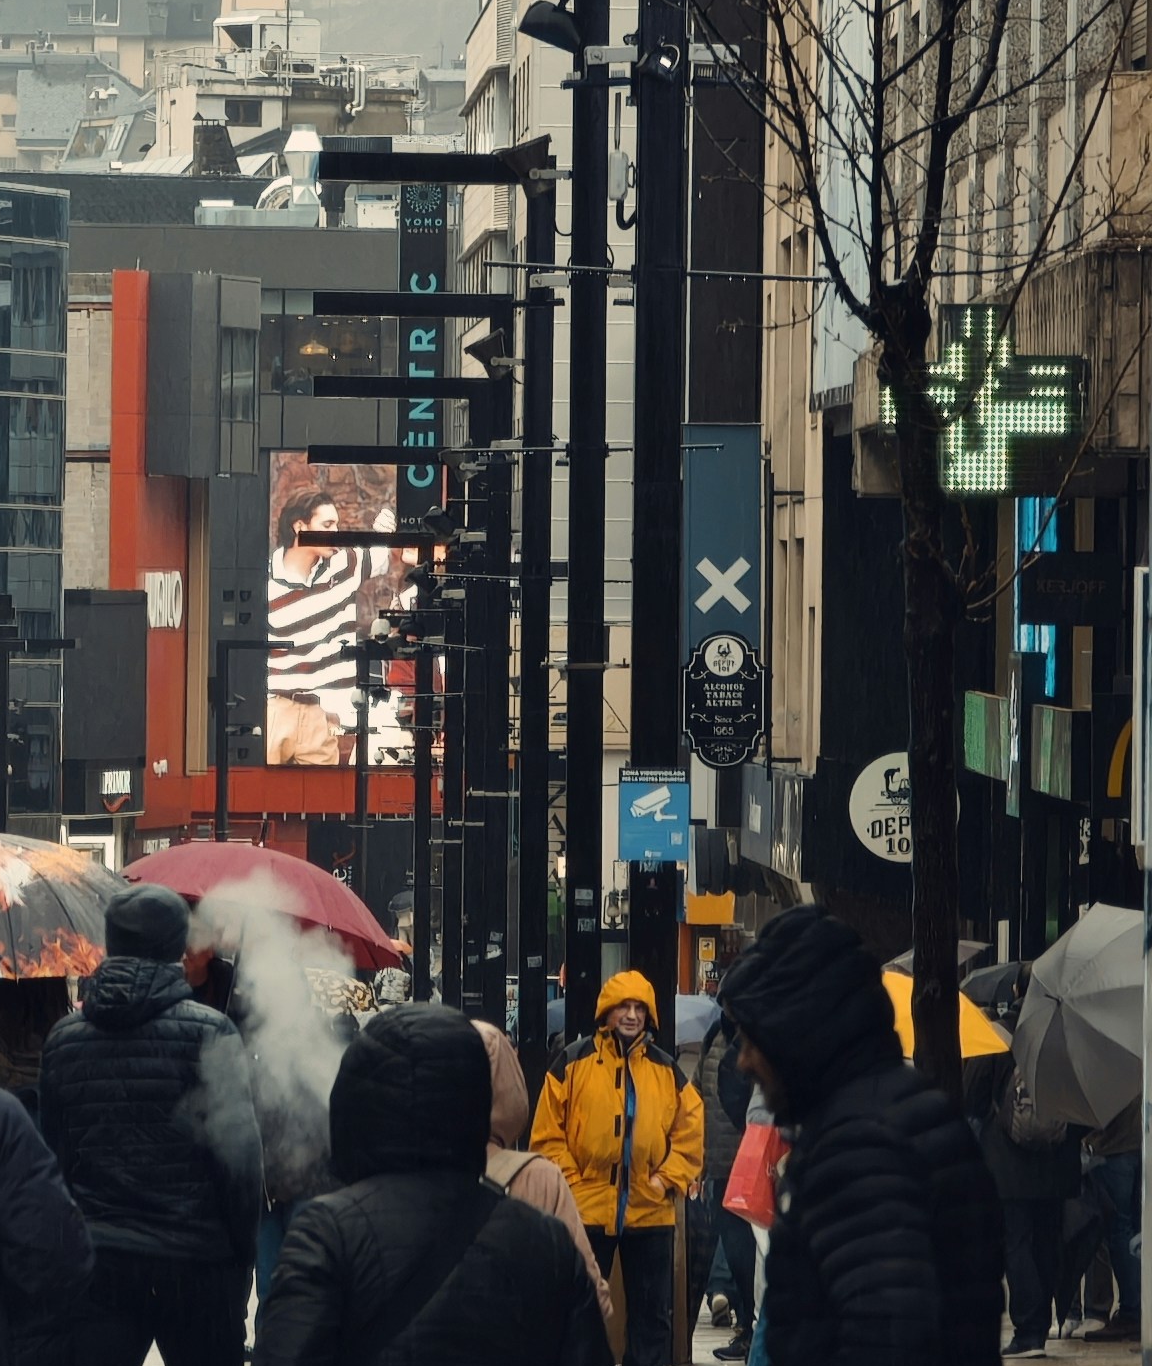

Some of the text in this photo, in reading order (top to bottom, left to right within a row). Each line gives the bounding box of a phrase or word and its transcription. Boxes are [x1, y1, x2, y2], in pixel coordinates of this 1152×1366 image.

[404, 218, 442, 227] YOMO
[403, 272, 437, 488] CÈNTRC
[703, 683, 745, 691] ALCOHOL
[705, 699, 743, 707] ALTRES
[714, 715, 733, 723] Since
[870, 816, 911, 839] DEP
[885, 837, 911, 855] 10
